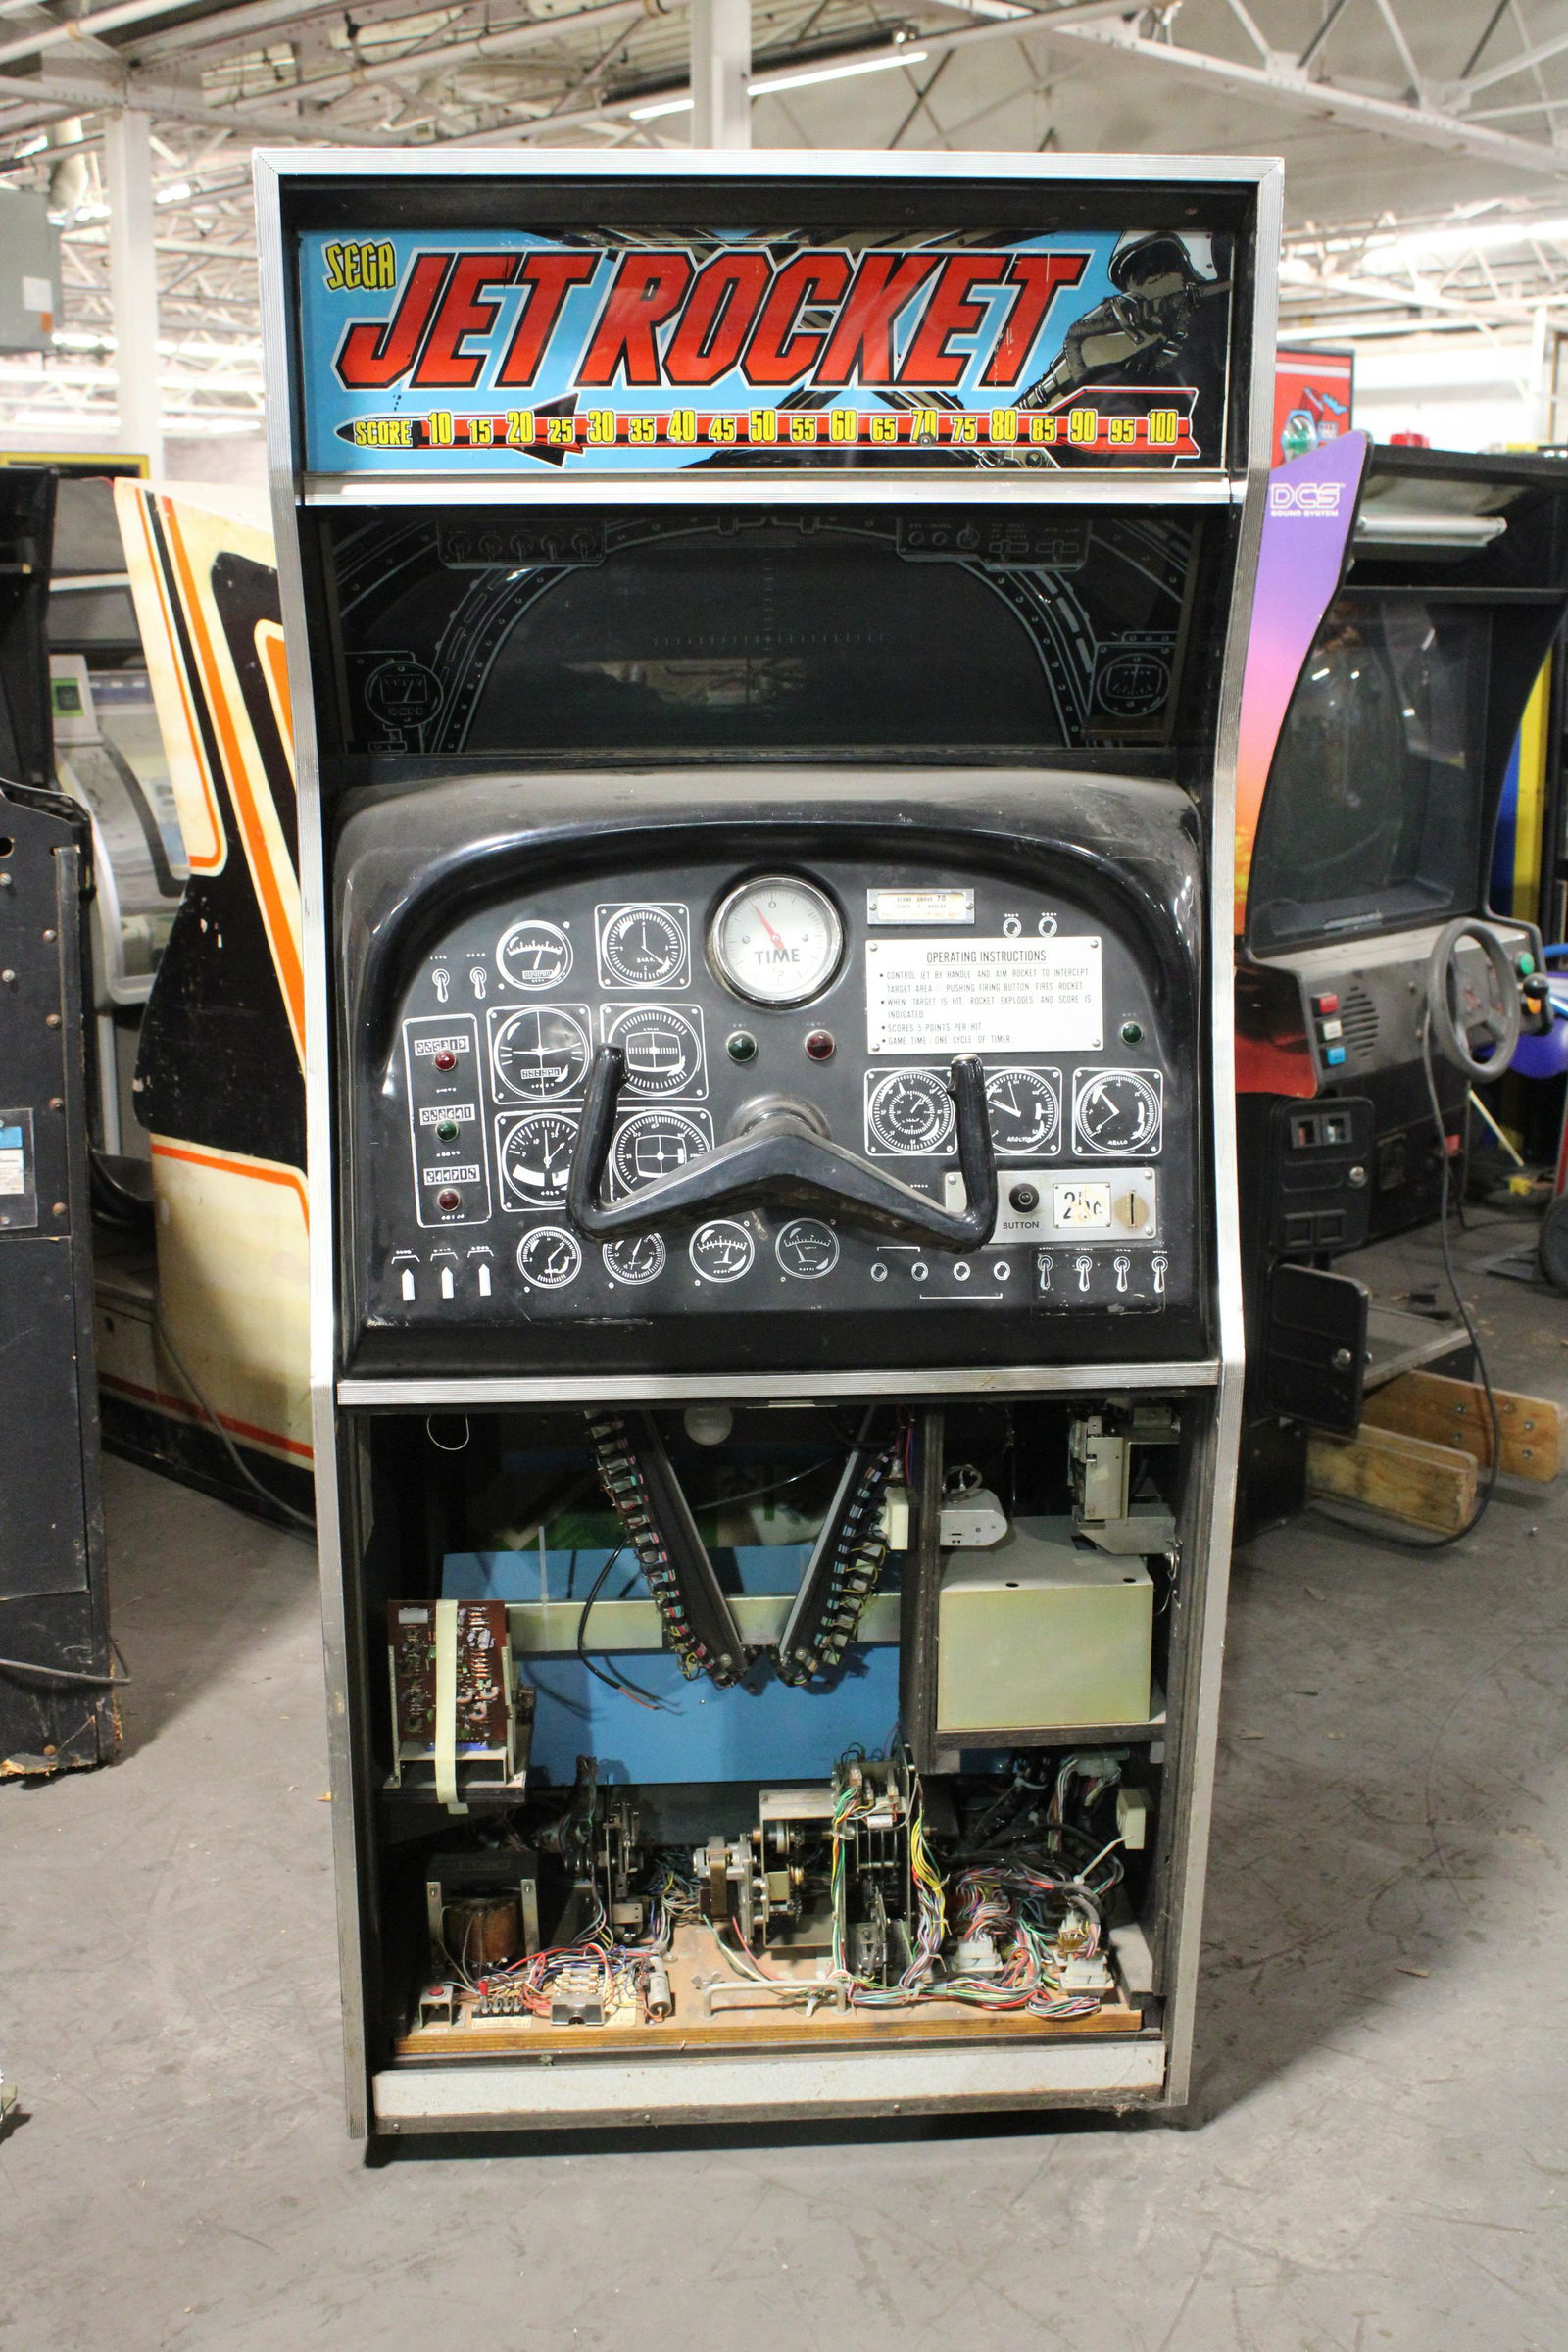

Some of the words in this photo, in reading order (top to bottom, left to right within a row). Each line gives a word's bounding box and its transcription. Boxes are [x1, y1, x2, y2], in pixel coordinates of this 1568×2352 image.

[324, 239, 397, 291] SEGA
[335, 251, 602, 389] JET
[572, 251, 1086, 387] ROCKET
[354, 419, 413, 447] SCORE
[427, 411, 453, 444] 10
[469, 419, 493, 444] 15
[506, 411, 535, 444] 20
[548, 418, 573, 444] 25
[588, 410, 615, 444] 30
[629, 418, 655, 443] 35
[669, 410, 696, 443] 40
[710, 418, 735, 442] 45
[750, 409, 776, 442] 50
[791, 417, 816, 442] 55
[830, 409, 857, 442] 60
[871, 417, 896, 442] 65
[911, 409, 937, 444] 70
[952, 417, 976, 442] 75
[991, 409, 1016, 443] 80
[1031, 417, 1056, 442] 85
[1070, 409, 1097, 443] 90
[1110, 418, 1135, 443] 95
[1148, 409, 1178, 444] 100
[1270, 482, 1341, 510] DCS
[755, 948, 801, 965] TIME
[926, 951, 977, 963] OPERATING
[980, 950, 1047, 962] INSTRUCTIONS
[887, 971, 915, 980] CONTROL
[935, 970, 942, 979] BY
[1042, 968, 1050, 977] TO
[979, 983, 1000, 992] FIRING
[1035, 982, 1054, 991] FIRES
[970, 996, 994, 1004] ROCKET
[1001, 996, 1034, 1004] EXPLODES
[1058, 995, 1079, 1004] SCORE
[888, 1023, 914, 1033] SCORES
